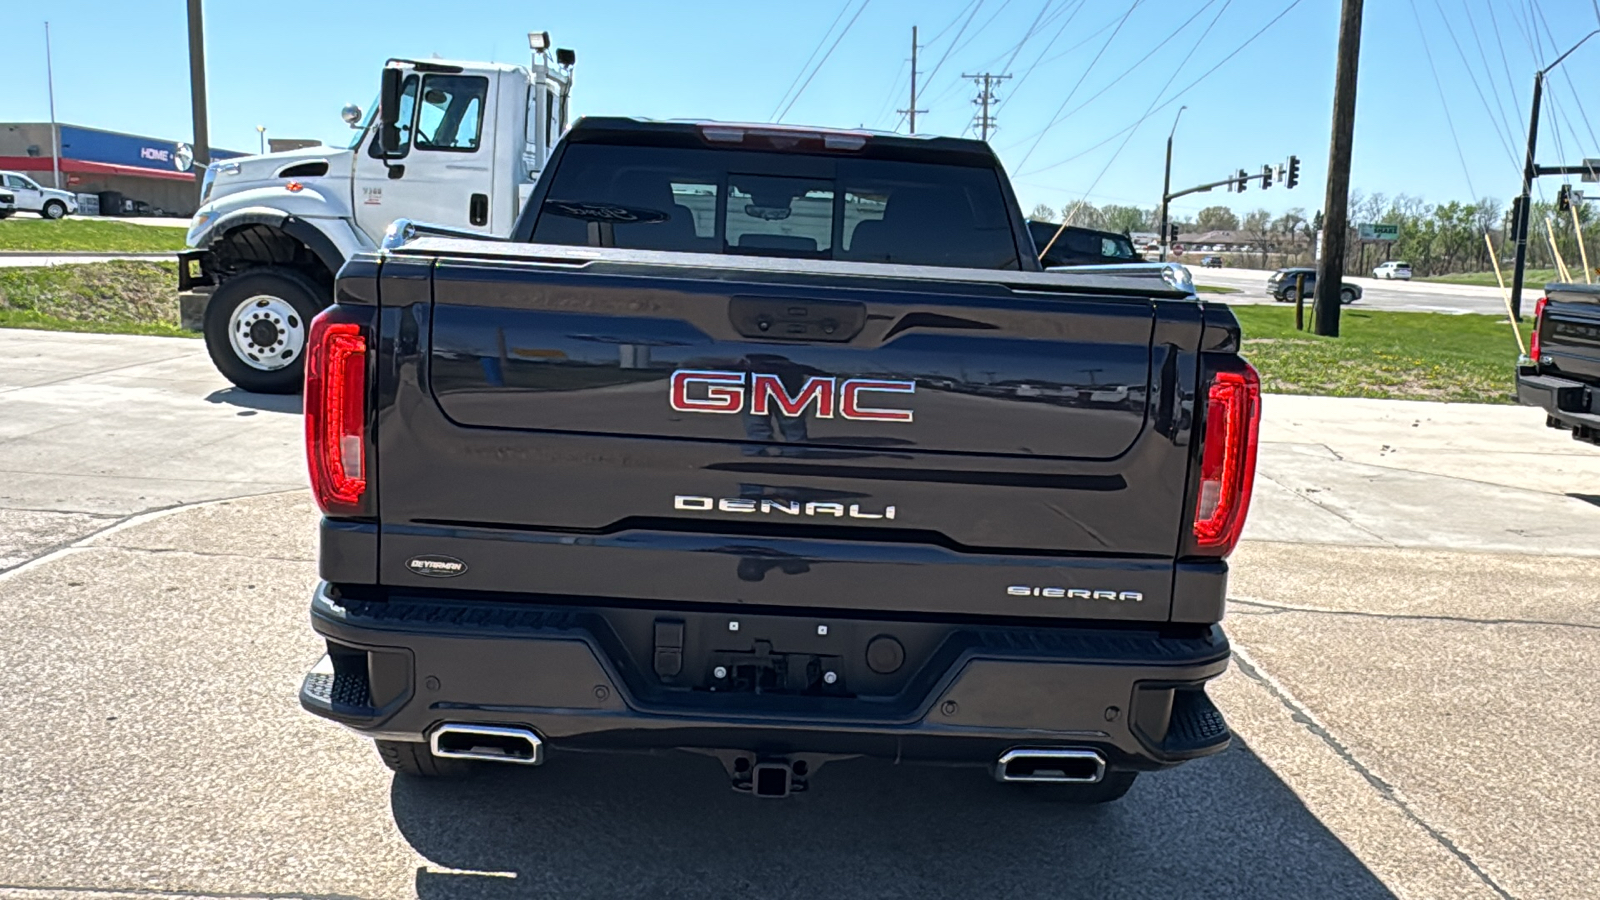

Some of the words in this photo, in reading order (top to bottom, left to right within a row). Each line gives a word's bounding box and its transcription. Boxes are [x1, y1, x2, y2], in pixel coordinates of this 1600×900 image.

[141, 147, 169, 161] HOME
[670, 369, 916, 422] GMC
[674, 495, 896, 520] DENALI
[1007, 585, 1143, 602] SIERRA
